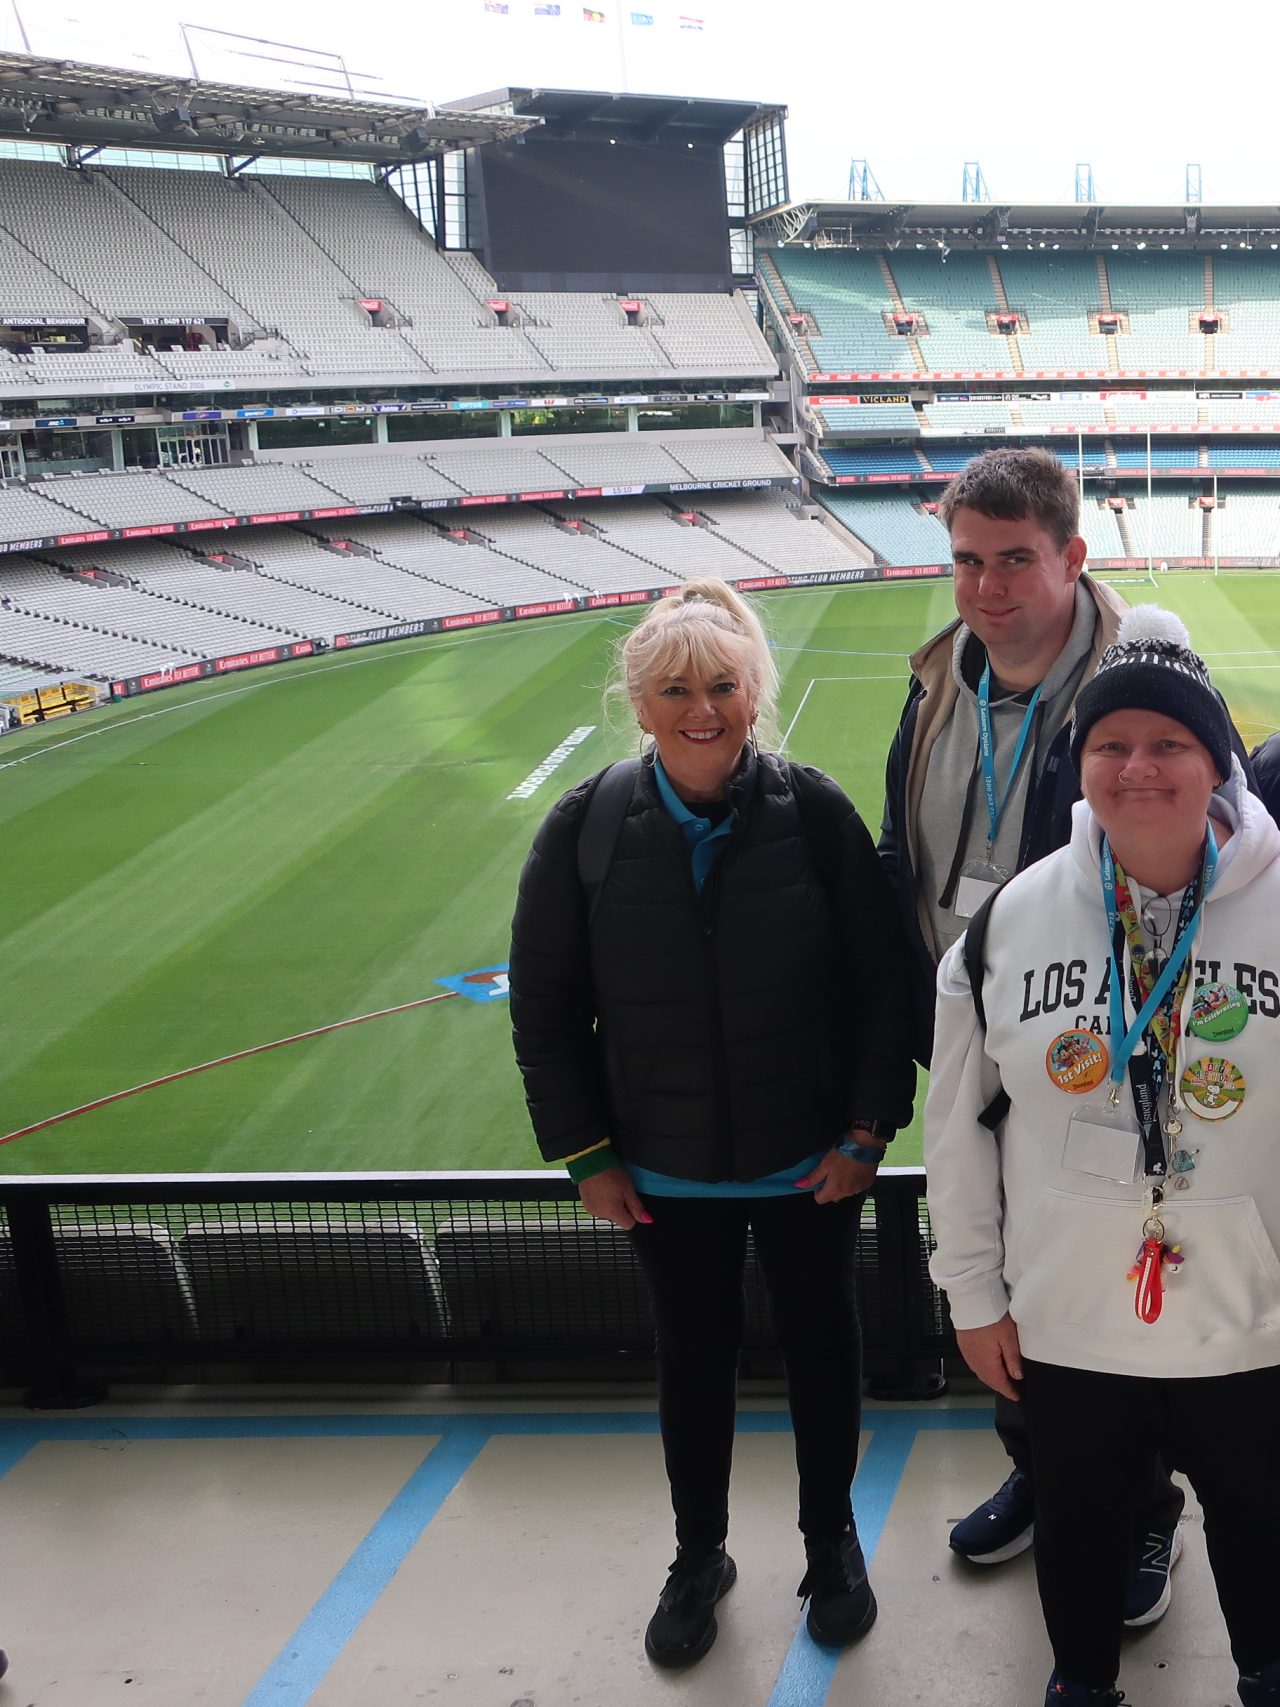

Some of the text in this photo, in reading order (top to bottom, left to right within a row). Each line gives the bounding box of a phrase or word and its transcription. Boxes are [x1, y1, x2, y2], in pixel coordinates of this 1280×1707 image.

[3, 317, 46, 326] ANTISOCIAL
[134, 383, 162, 392] OLYMPIC
[669, 479, 772, 492] MELBOURNE CRICKET GROUND
[10, 539, 43, 551] MEMBERS
[809, 573, 828, 583] CLUB
[829, 570, 865, 582] MEMBERS
[519, 606, 546, 616] Emirates
[445, 616, 473, 627] Emirates
[367, 628, 387, 641] CLUB
[387, 622, 425, 638] MEMBERS
[219, 656, 249, 670] Emirates
[1019, 959, 1088, 1023] LOS
[1057, 1053, 1103, 1084] 1st Visit!
